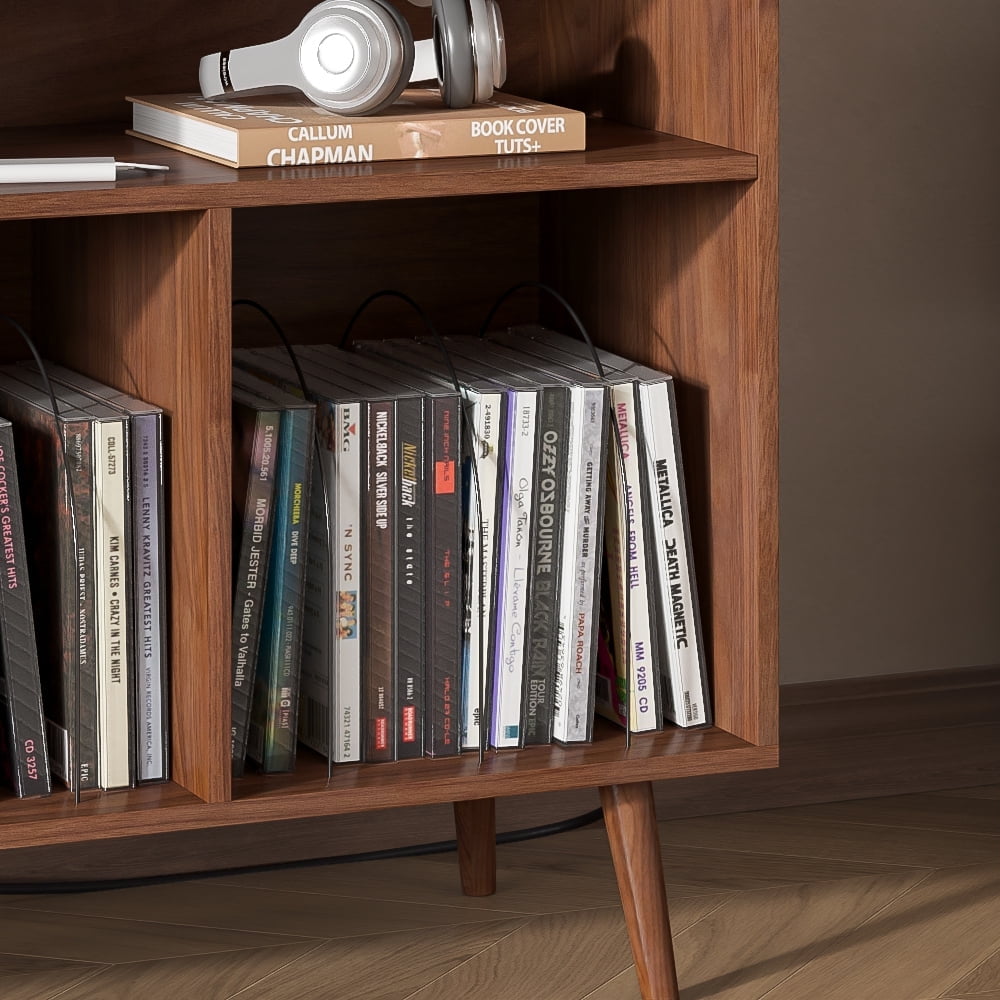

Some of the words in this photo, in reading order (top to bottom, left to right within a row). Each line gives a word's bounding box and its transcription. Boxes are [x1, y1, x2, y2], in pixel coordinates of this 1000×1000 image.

[288, 125, 353, 142] CALLUM
[471, 120, 513, 137] BOOK
[515, 117, 565, 135] COVER
[266, 144, 373, 167] CHAPMAN
[494, 138, 541, 155] TUTS+
[375, 411, 388, 467] NICKELBACK
[616, 402, 630, 459] METALLICA
[541, 430, 558, 478] OZZY
[375, 471, 388, 499] SILVER
[401, 442, 417, 508] Nickelback
[585, 461, 594, 493] GETTING
[292, 483, 302, 525] MORCHEEBA
[514, 477, 529, 508] Olga
[583, 494, 592, 514] AWAY
[655, 459, 674, 528] METALLICA
[142, 496, 150, 530] LENNY
[252, 498, 266, 543] MORBID
[375, 500, 388, 518] SIDE
[375, 518, 388, 529] UP
[536, 478, 556, 576] OSBOURNE
[1, 516, 14, 564] GREATEST
[109, 536, 119, 552] KIM
[290, 531, 299, 547] DIVE
[582, 526, 590, 559] MURDER
[143, 535, 151, 577] KRAVITZ
[246, 545, 261, 589] JESTER
[289, 548, 298, 565] DEEP
[344, 544, 353, 582] SYNC
[665, 538, 682, 581] DEATH
[7, 568, 18, 590] HITS
[110, 555, 119, 589] CARNES
[629, 566, 640, 589] HELL
[110, 599, 120, 626] CRAZY
[143, 581, 151, 632] GREATEST
[241, 599, 254, 630] Gates
[669, 583, 689, 650] MAGNETIC
[110, 629, 120, 638] IN
[239, 632, 249, 644] to
[577, 611, 586, 638] PAPA
[111, 640, 120, 657] THE
[144, 636, 152, 659] HITS
[506, 622, 521, 674] Contigo
[575, 640, 584, 675] ROACH
[635, 641, 645, 661] MM
[111, 659, 121, 684] NIGHT
[234, 645, 249, 687] Valhalla
[637, 666, 647, 692] 9205
[530, 680, 538, 716] EDITION
[537, 679, 546, 704] TOUR
[343, 706, 351, 728] 74321
[639, 697, 648, 714] CD
[24, 739, 34, 753] CD
[343, 730, 351, 752] 47164
[27, 756, 38, 780] 3257
[80, 763, 88, 782] EPIC
